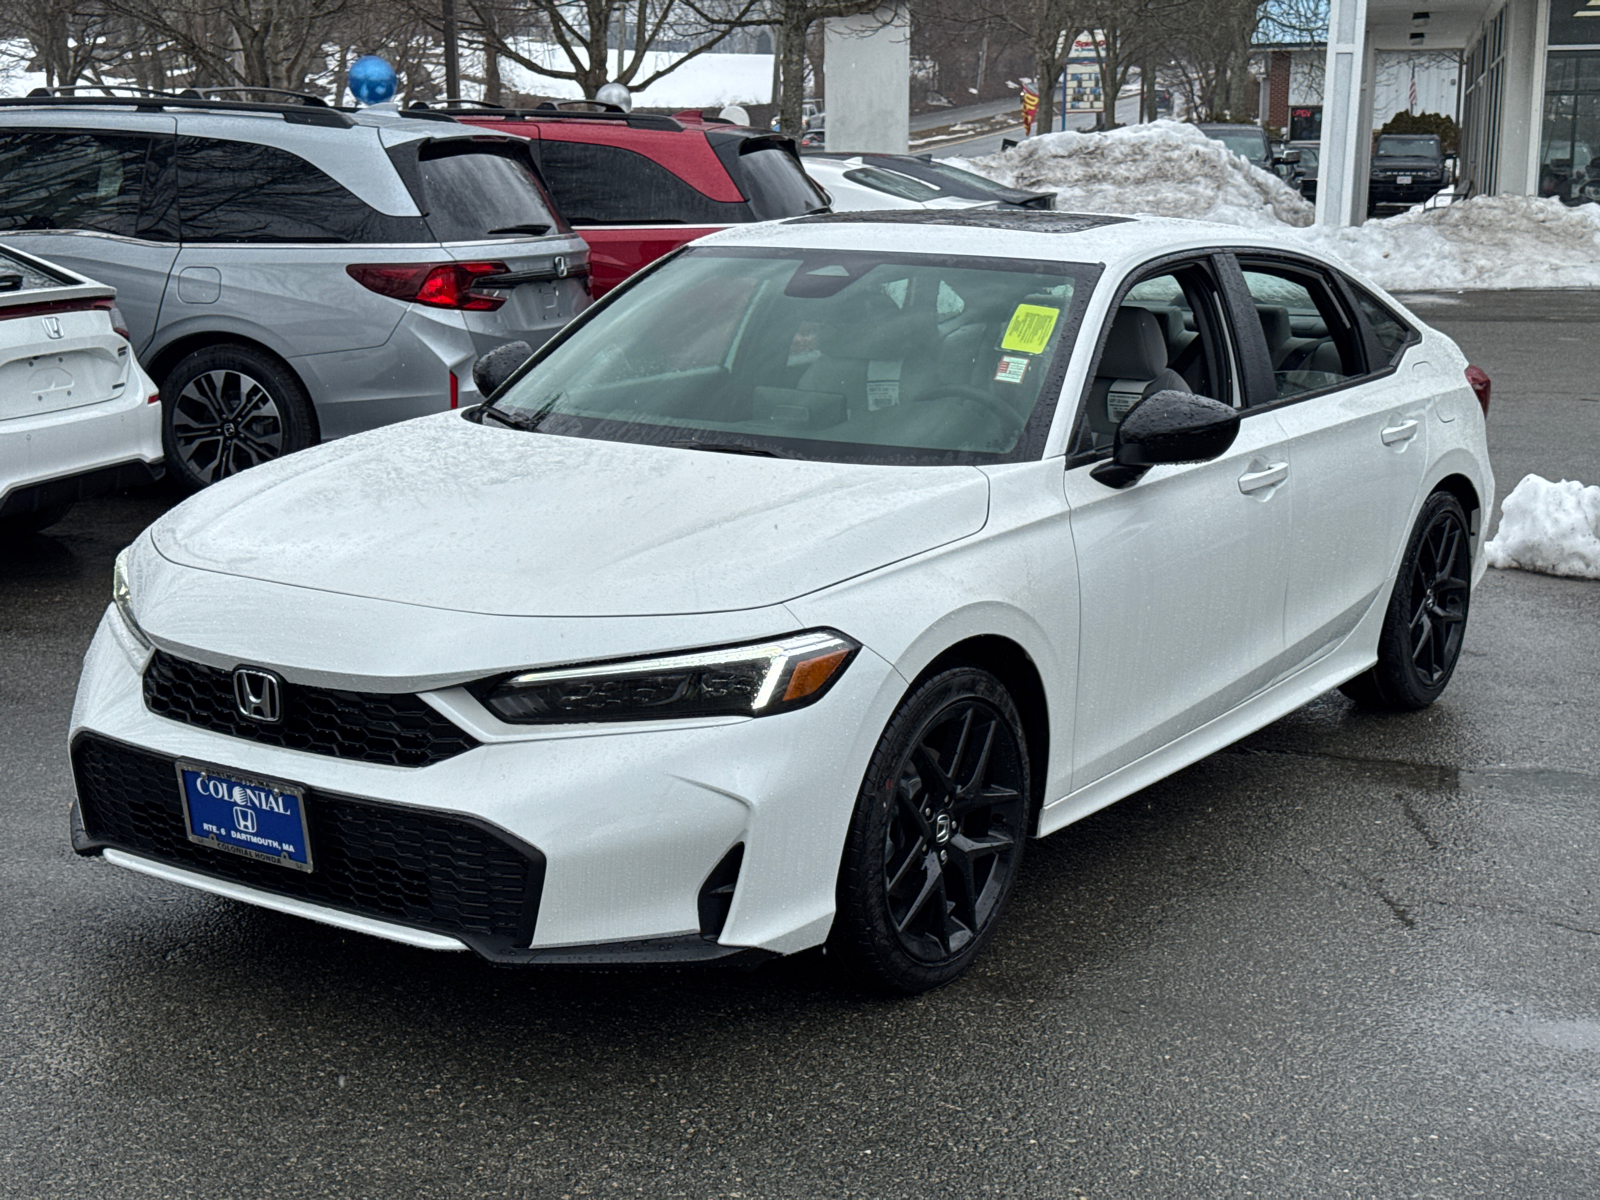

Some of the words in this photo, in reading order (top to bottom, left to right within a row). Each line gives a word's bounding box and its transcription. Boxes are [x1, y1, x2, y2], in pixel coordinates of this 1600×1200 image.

[196, 777, 291, 815] COLONIAL
[203, 822, 220, 834] RTE.
[220, 828, 226, 836] 6
[282, 843, 295, 852] MA
[217, 842, 253, 858] COLONIAL
[254, 852, 281, 864] HONDA
